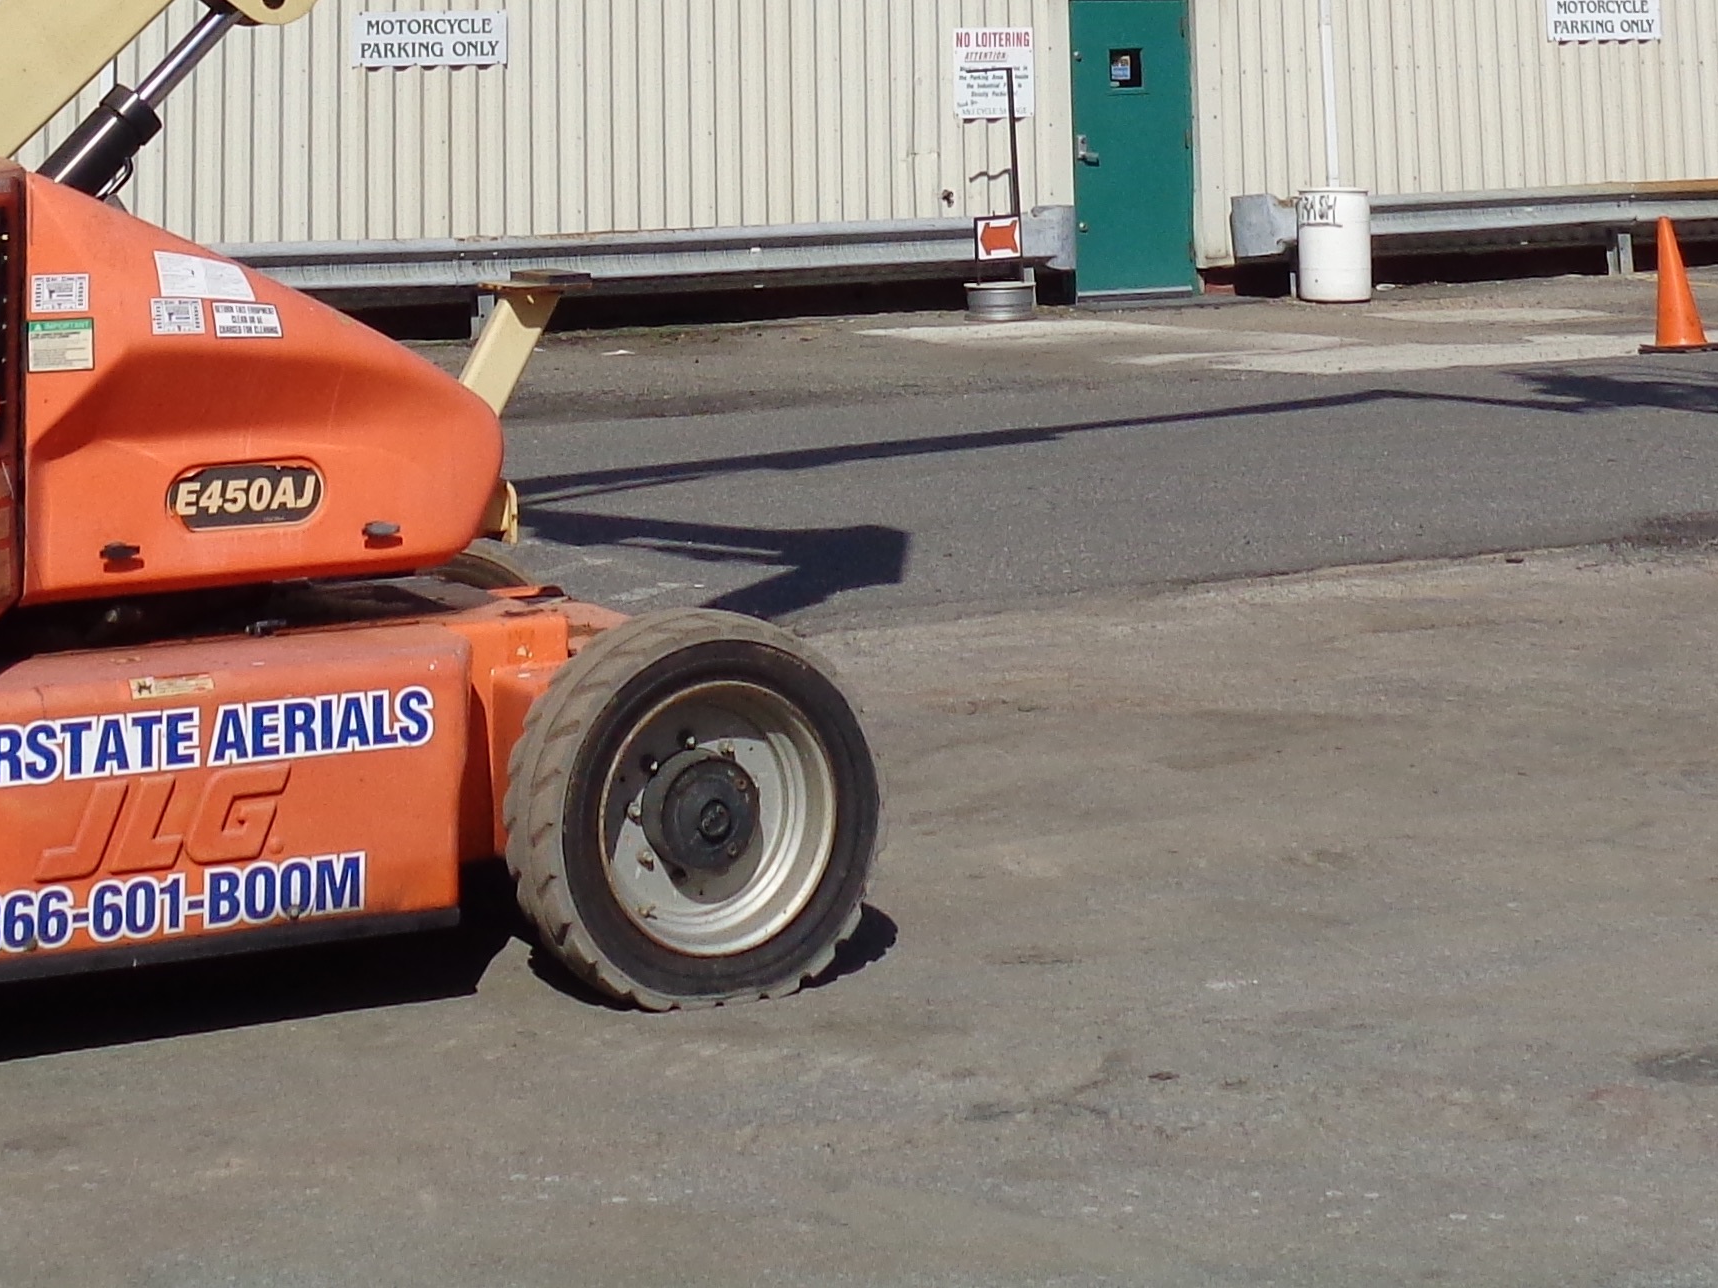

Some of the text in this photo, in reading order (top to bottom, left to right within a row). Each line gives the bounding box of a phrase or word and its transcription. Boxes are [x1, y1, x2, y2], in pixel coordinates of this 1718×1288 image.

[1556, 0, 1649, 14] MOTORCYCLE
[366, 18, 493, 36] MOTORCYCLE
[1553, 19, 1654, 34] PARKING ONLY
[955, 31, 1030, 48] NO LOITERING
[360, 40, 500, 59] PARKING ONLY
[1297, 194, 1337, 225] RASH
[175, 474, 316, 516] E450AJ
[210, 688, 433, 763] AERIALS
[33, 764, 291, 883] JLG
